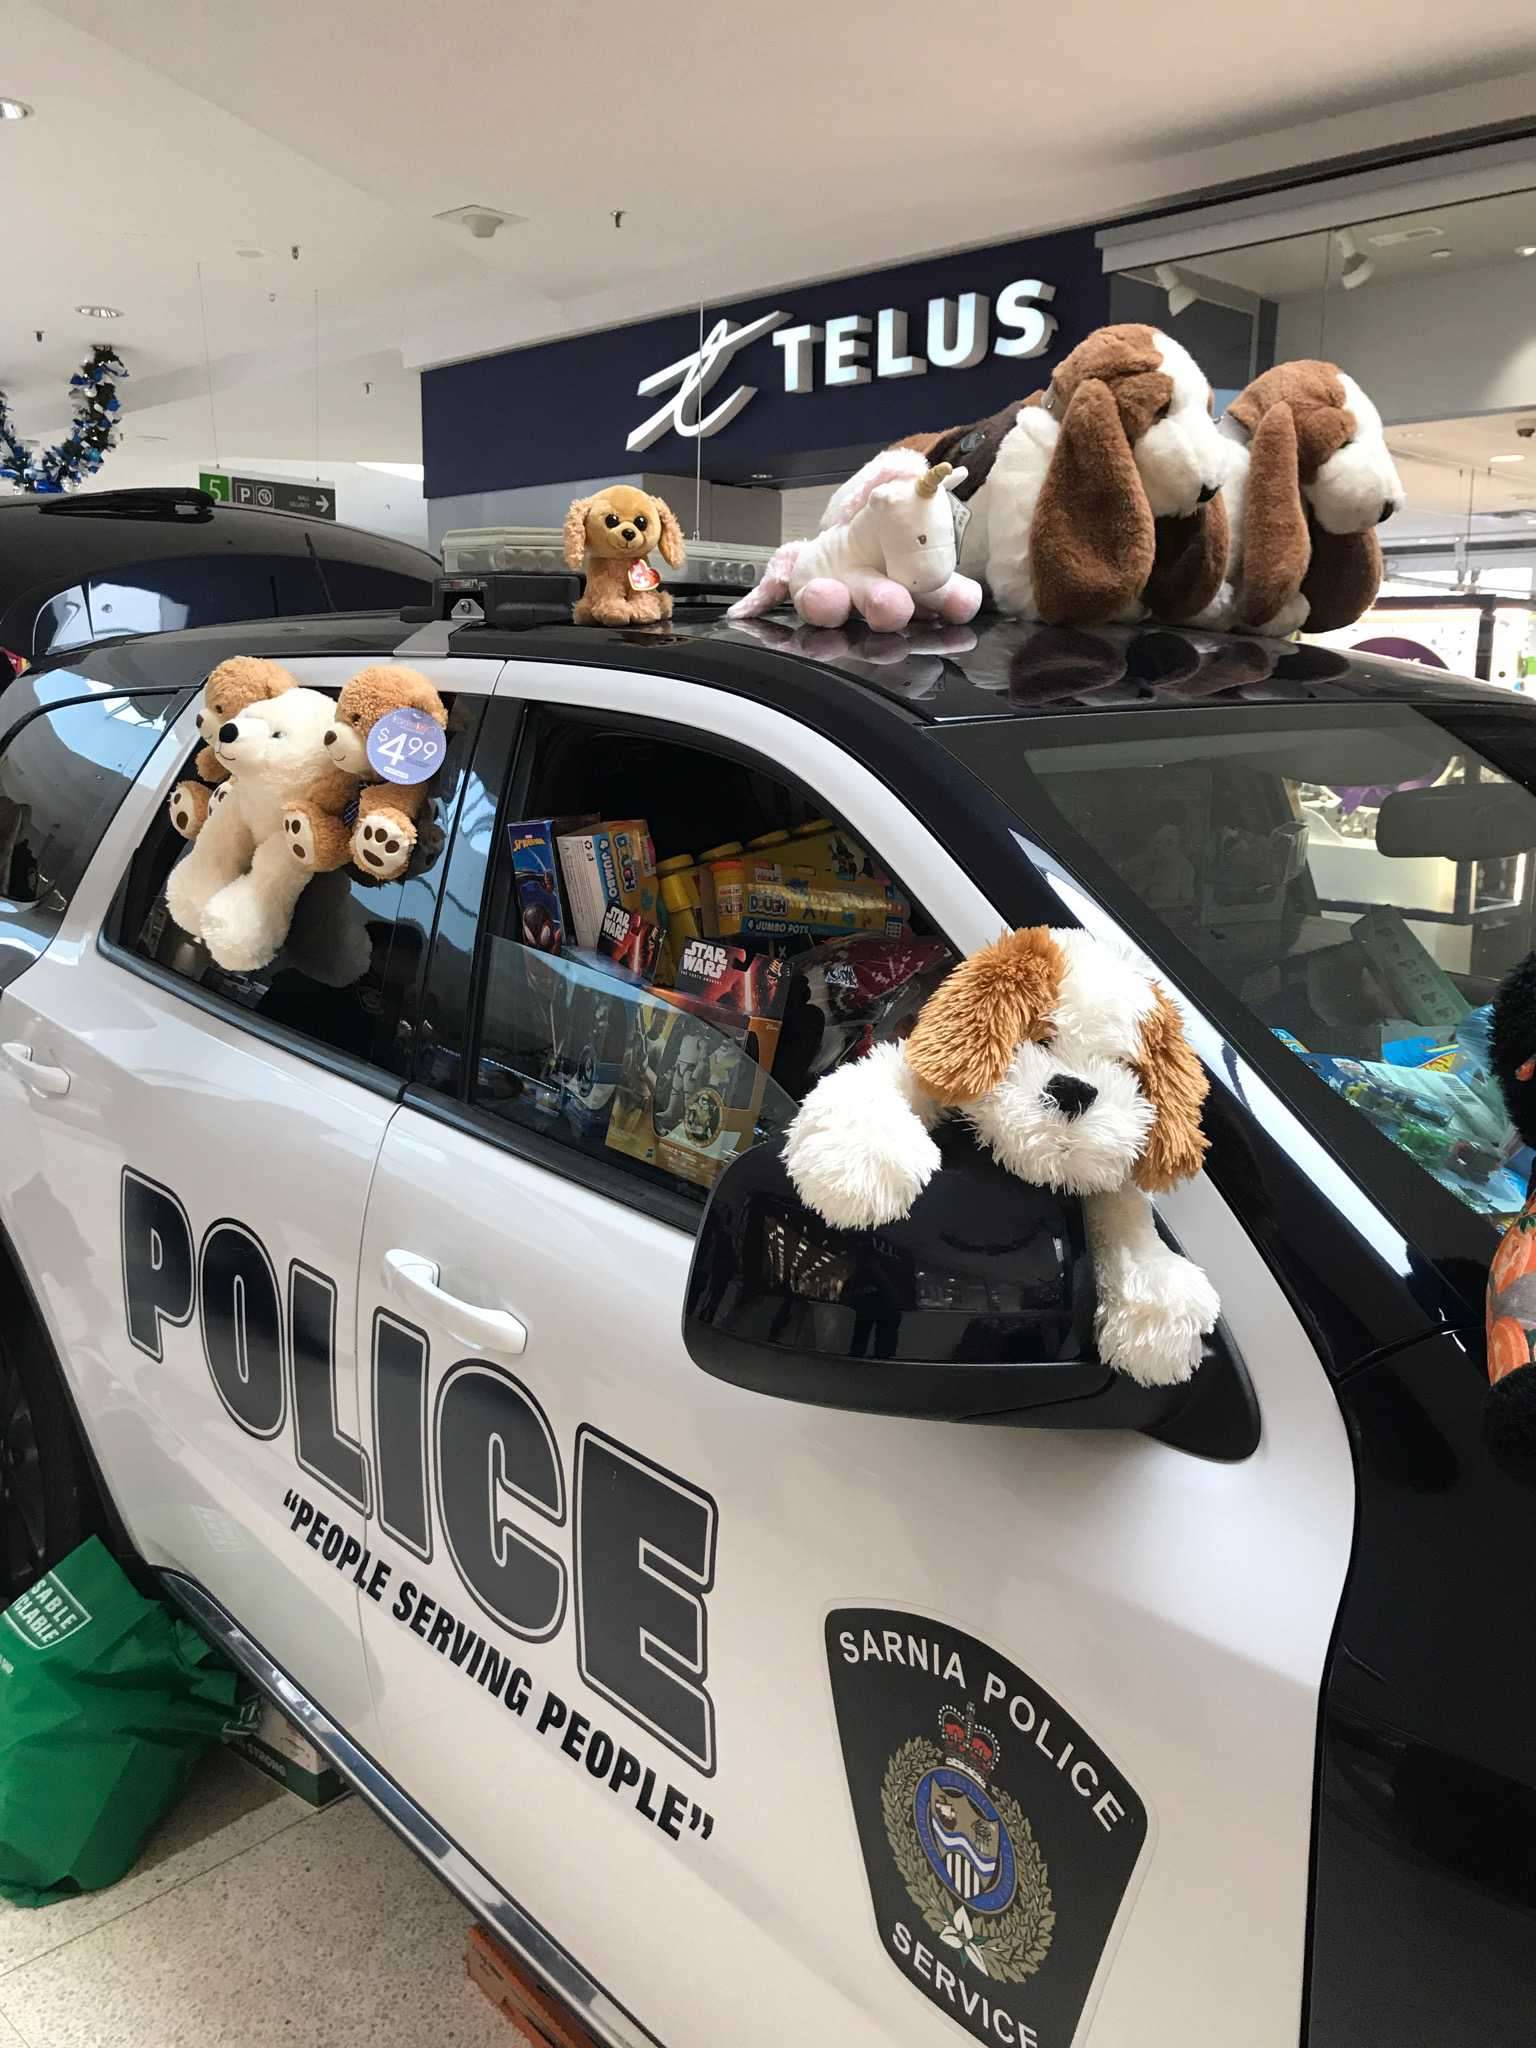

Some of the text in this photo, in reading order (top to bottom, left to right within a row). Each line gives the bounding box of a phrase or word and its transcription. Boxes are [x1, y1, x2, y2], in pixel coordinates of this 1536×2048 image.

[773, 279, 1058, 394] TELUS
[209, 479, 222, 502] 5
[602, 852, 618, 898] JUMBO
[602, 917, 630, 942] WARS
[605, 905, 631, 929] STAR
[755, 920, 786, 933] JUMBO
[682, 954, 728, 979] WARS
[683, 940, 728, 965] STAR
[120, 1164, 719, 1779] POLICE
[391, 1579, 535, 1717] SERVING
[839, 1629, 1126, 1832] SARNIA POLICE
[891, 1921, 1039, 2048] SERVICE
